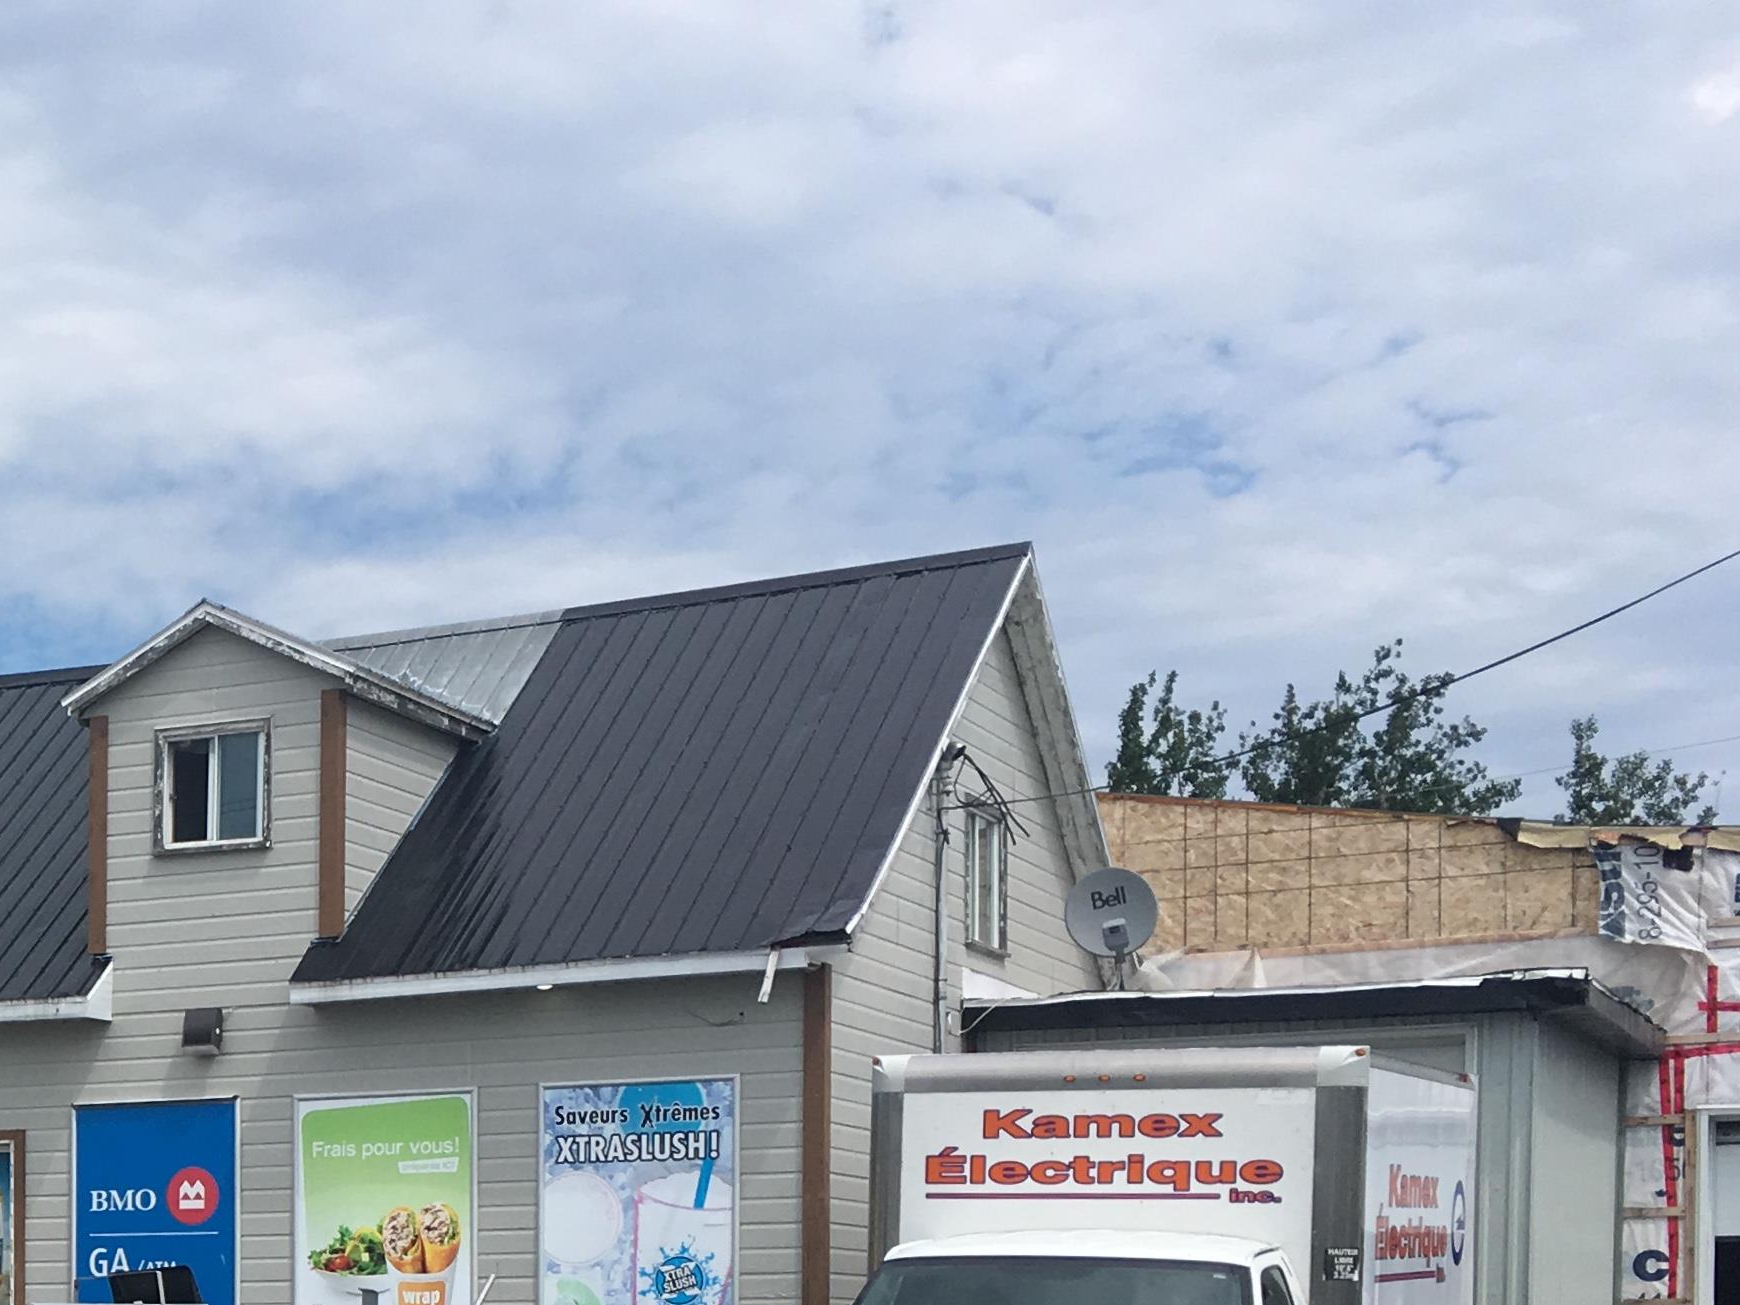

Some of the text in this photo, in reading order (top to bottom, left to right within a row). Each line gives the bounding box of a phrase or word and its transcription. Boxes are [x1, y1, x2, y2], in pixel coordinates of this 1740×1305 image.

[1090, 886, 1127, 910] Bell
[554, 1101, 720, 1128] Saveurs Xtrêmes
[982, 1109, 1223, 1139] Kamex
[311, 1136, 460, 1160] Frais pour vous!
[556, 1130, 721, 1164] XTRASLUSH!
[925, 1146, 1284, 1191] Électrique
[1229, 1188, 1283, 1203] inc.
[1388, 1164, 1439, 1208] Kamex
[89, 1188, 157, 1212] BMO
[1375, 1202, 1447, 1268] Électrique
[89, 1248, 130, 1277] GA
[663, 1265, 692, 1282] XTRA
[663, 1276, 697, 1294] SLUSH
